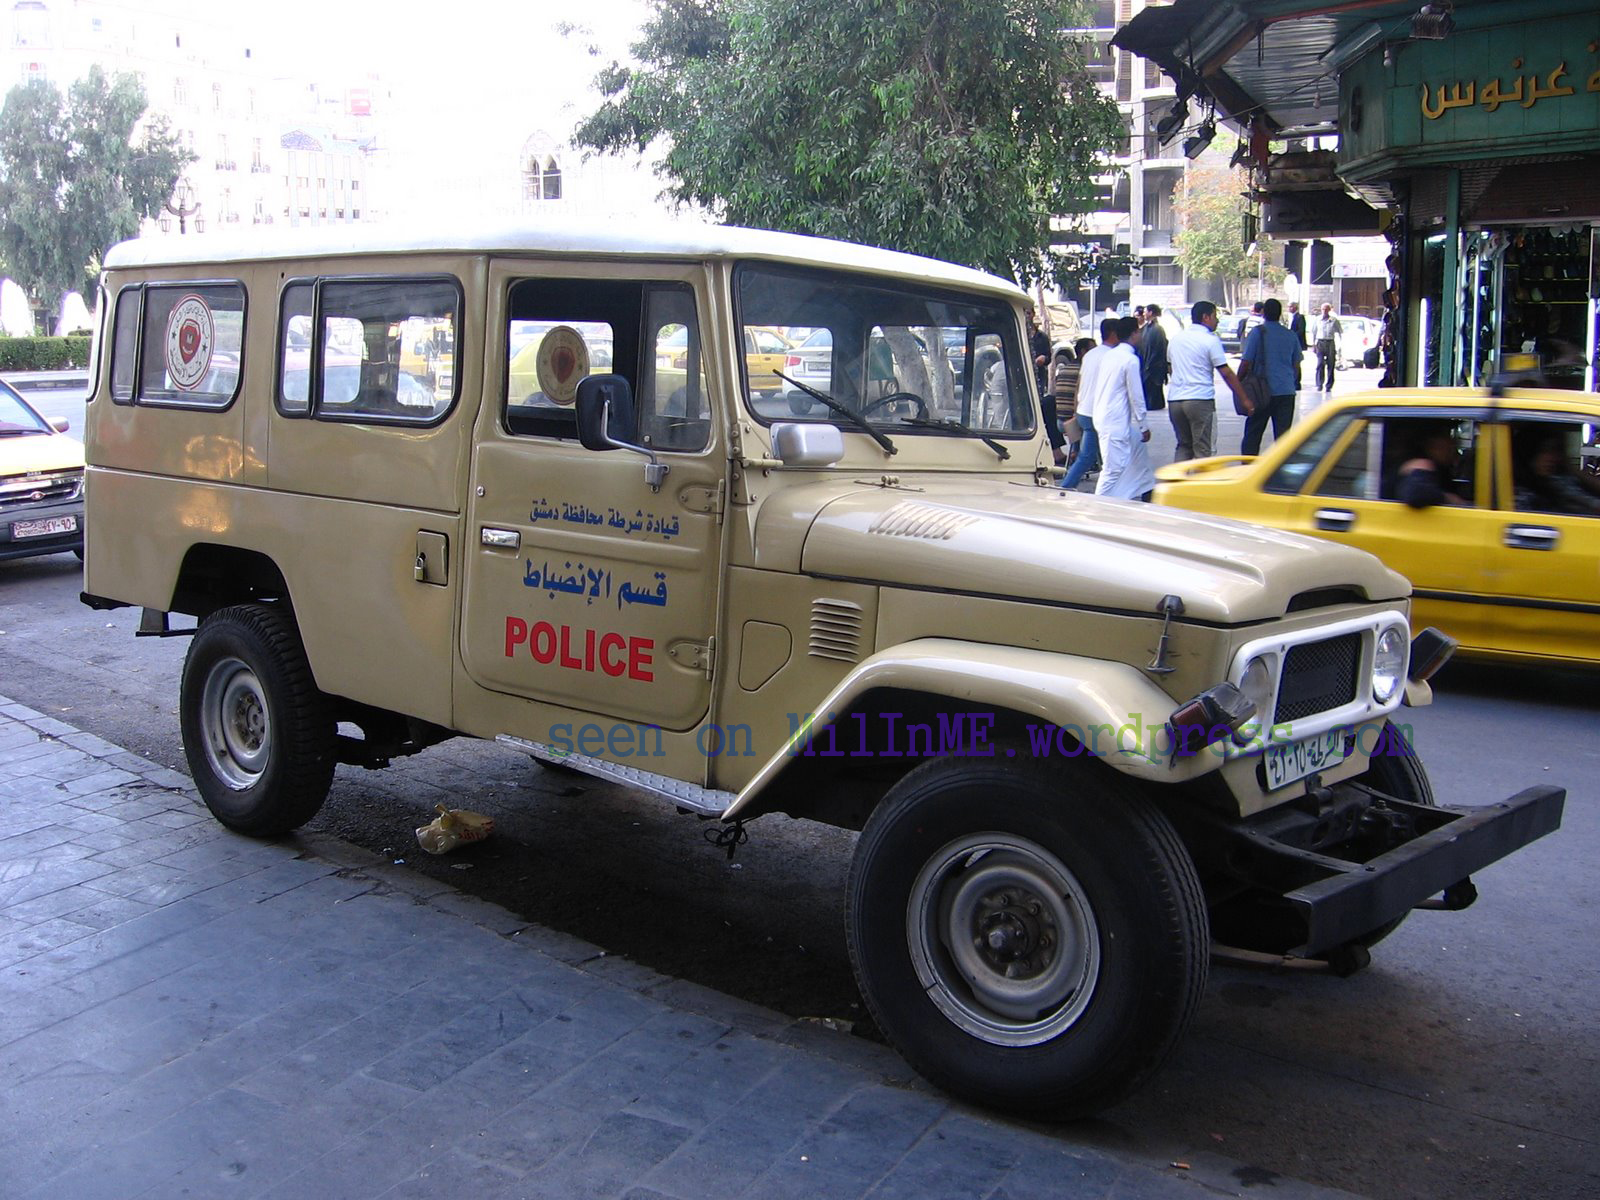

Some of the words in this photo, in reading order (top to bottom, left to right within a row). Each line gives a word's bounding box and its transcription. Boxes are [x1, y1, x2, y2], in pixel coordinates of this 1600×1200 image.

[1422, 58, 1574, 120] عرنوس
[530, 498, 559, 522] دمشق
[562, 502, 604, 525] محافظة
[608, 508, 643, 534] شرطة
[646, 514, 680, 540] قيادة
[523, 558, 612, 606] الإنضباط
[618, 572, 668, 611] قسم
[505, 616, 654, 682] POLICE
